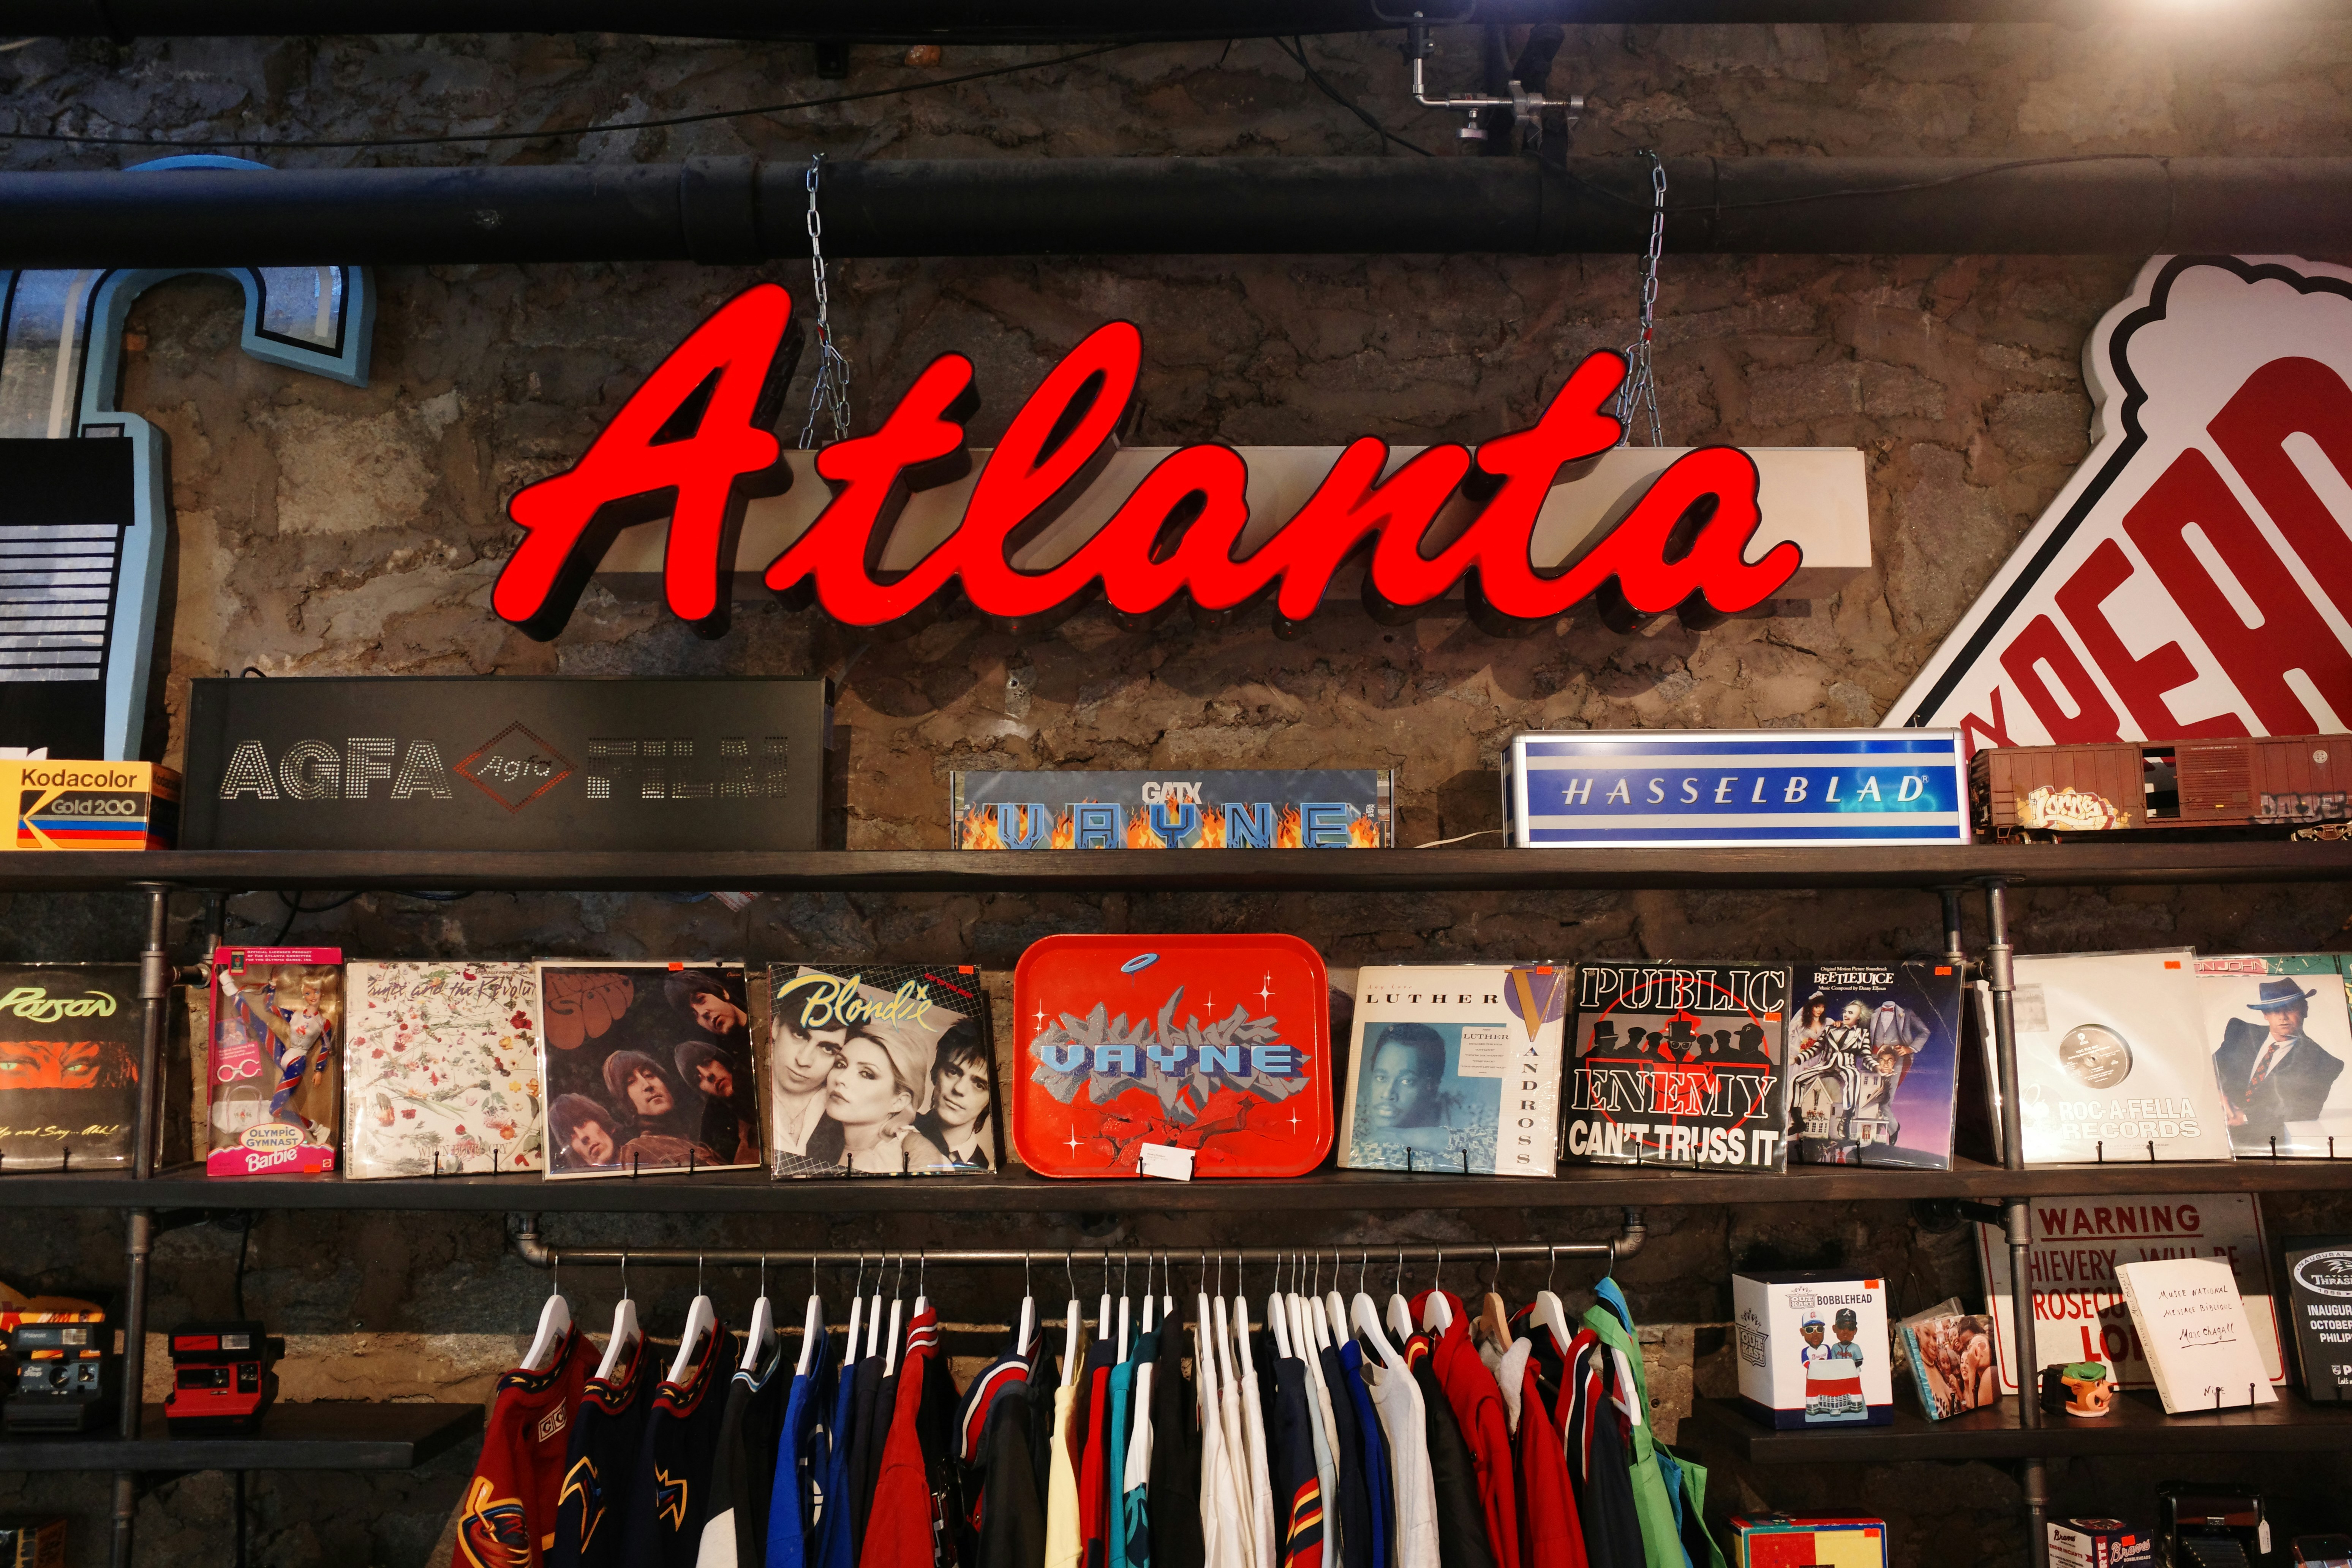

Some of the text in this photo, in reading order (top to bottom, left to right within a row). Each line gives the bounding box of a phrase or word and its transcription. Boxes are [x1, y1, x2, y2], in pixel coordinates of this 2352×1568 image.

[494, 283, 1803, 626] Atlanta
[21, 768, 138, 788] Kodacolor
[219, 738, 452, 800] AGFA
[477, 755, 552, 782] Agfa
[1142, 782, 1203, 805] GATX
[51, 799, 136, 815] Gold 200
[2218, 961, 2268, 971] JOHN
[1813, 972, 1894, 985] BEETLEJUICE
[1365, 994, 1499, 1004] LUTHER
[1579, 967, 1785, 1013] PUBLIC
[777, 973, 937, 1033] Blondie
[1571, 1069, 1778, 1119] ENEMY
[2059, 1098, 2197, 1121] ROC-A-FELLA
[15, 1127, 41, 1135] and
[2061, 1120, 2202, 1140] RECORDS
[247, 1138, 298, 1147] GYMNAST
[1569, 1119, 1780, 1166] CAN'T TRUSS IT
[245, 1148, 297, 1172] Barbie
[2038, 1204, 2200, 1235] WARNING
[2031, 1249, 2116, 1282] HIEVERY
[2296, 1252, 2347, 1271] INAUGURAL
[1817, 1294, 1872, 1305] BOBBLEHEAD
[1741, 1330, 1764, 1350] OUT
[2179, 1328, 2200, 1343] Marc
[1742, 1344, 1764, 1362] KAST
[2054, 1529, 2076, 1542] Braves
[2049, 1544, 2063, 1552] ENDER
[2110, 1539, 2151, 1565] Braves
